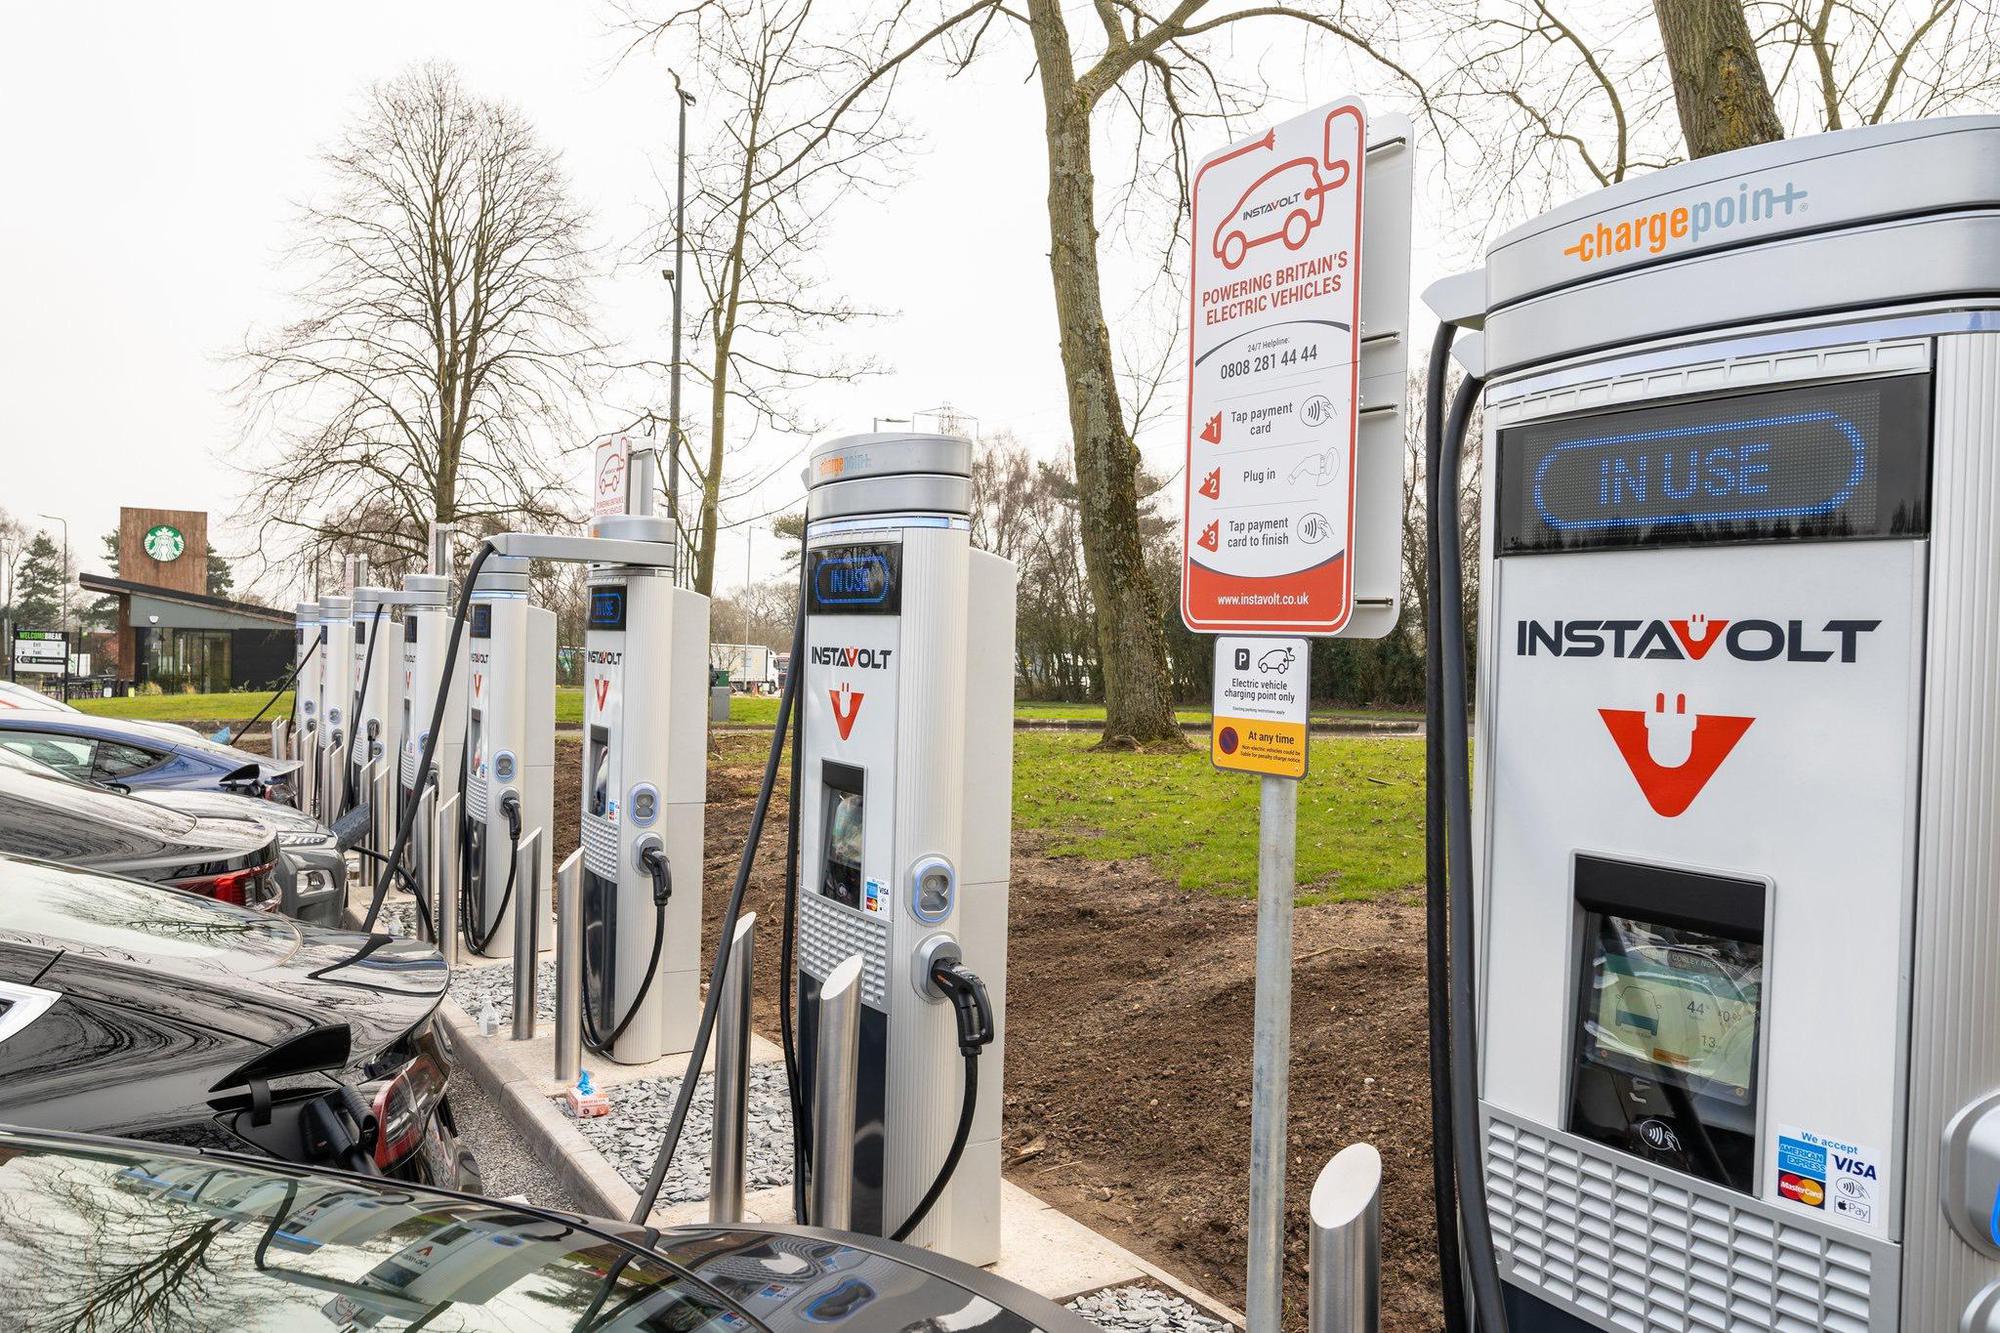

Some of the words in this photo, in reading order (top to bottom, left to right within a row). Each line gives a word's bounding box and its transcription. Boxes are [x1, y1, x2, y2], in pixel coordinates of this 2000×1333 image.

[1243, 192, 1301, 221] INSTAVOLT
[1202, 273, 1272, 307] POWERING
[1276, 251, 1348, 286] BRITAIN'S
[1206, 295, 1267, 326] ELECTRIC
[1271, 274, 1342, 308] VEHICLES
[1247, 342, 1261, 353] 24/7
[1262, 337, 1290, 349] Helpline:
[1220, 360, 1250, 380] 0808
[1254, 353, 1276, 373] 281
[1281, 349, 1297, 366] 44
[1301, 344, 1318, 362] 44
[1231, 411, 1248, 424] Tap
[1250, 402, 1293, 422] payment
[1212, 422, 1218, 438] 1
[1250, 421, 1272, 436] card
[1243, 469, 1264, 484] Plug
[1266, 468, 1276, 480] in
[1600, 454, 1647, 505] IN
[1663, 442, 1771, 500] USE
[1210, 479, 1217, 493] 2
[1229, 520, 1245, 534] Tap
[1247, 517, 1289, 533] payment
[1208, 530, 1216, 546] 3
[1227, 535, 1247, 548] card
[1250, 536, 1259, 547] to
[1262, 534, 1289, 546] finish
[1217, 592, 1309, 606] www.instavolt.co.uk
[1516, 616, 1882, 663] INSTAVOLT
[811, 647, 892, 670] INSTAVOLT
[1232, 679, 1259, 689] Electric
[1260, 680, 1287, 690] vehicle
[1224, 688, 1256, 702] charging
[1257, 691, 1277, 702] point
[1278, 693, 1295, 705] only
[1248, 730, 1257, 740] At
[1259, 733, 1274, 745] any
[1275, 732, 1295, 745] time
[1801, 1131, 1818, 1144] We
[1821, 1138, 1858, 1155] accept
[1779, 1143, 1824, 1163] AMERICAN
[1787, 1154, 1826, 1173] EXPRESS
[1831, 1153, 1877, 1181] VISA
[1780, 1181, 1824, 1200] MasterCard
[1848, 1202, 1868, 1218] Pay
